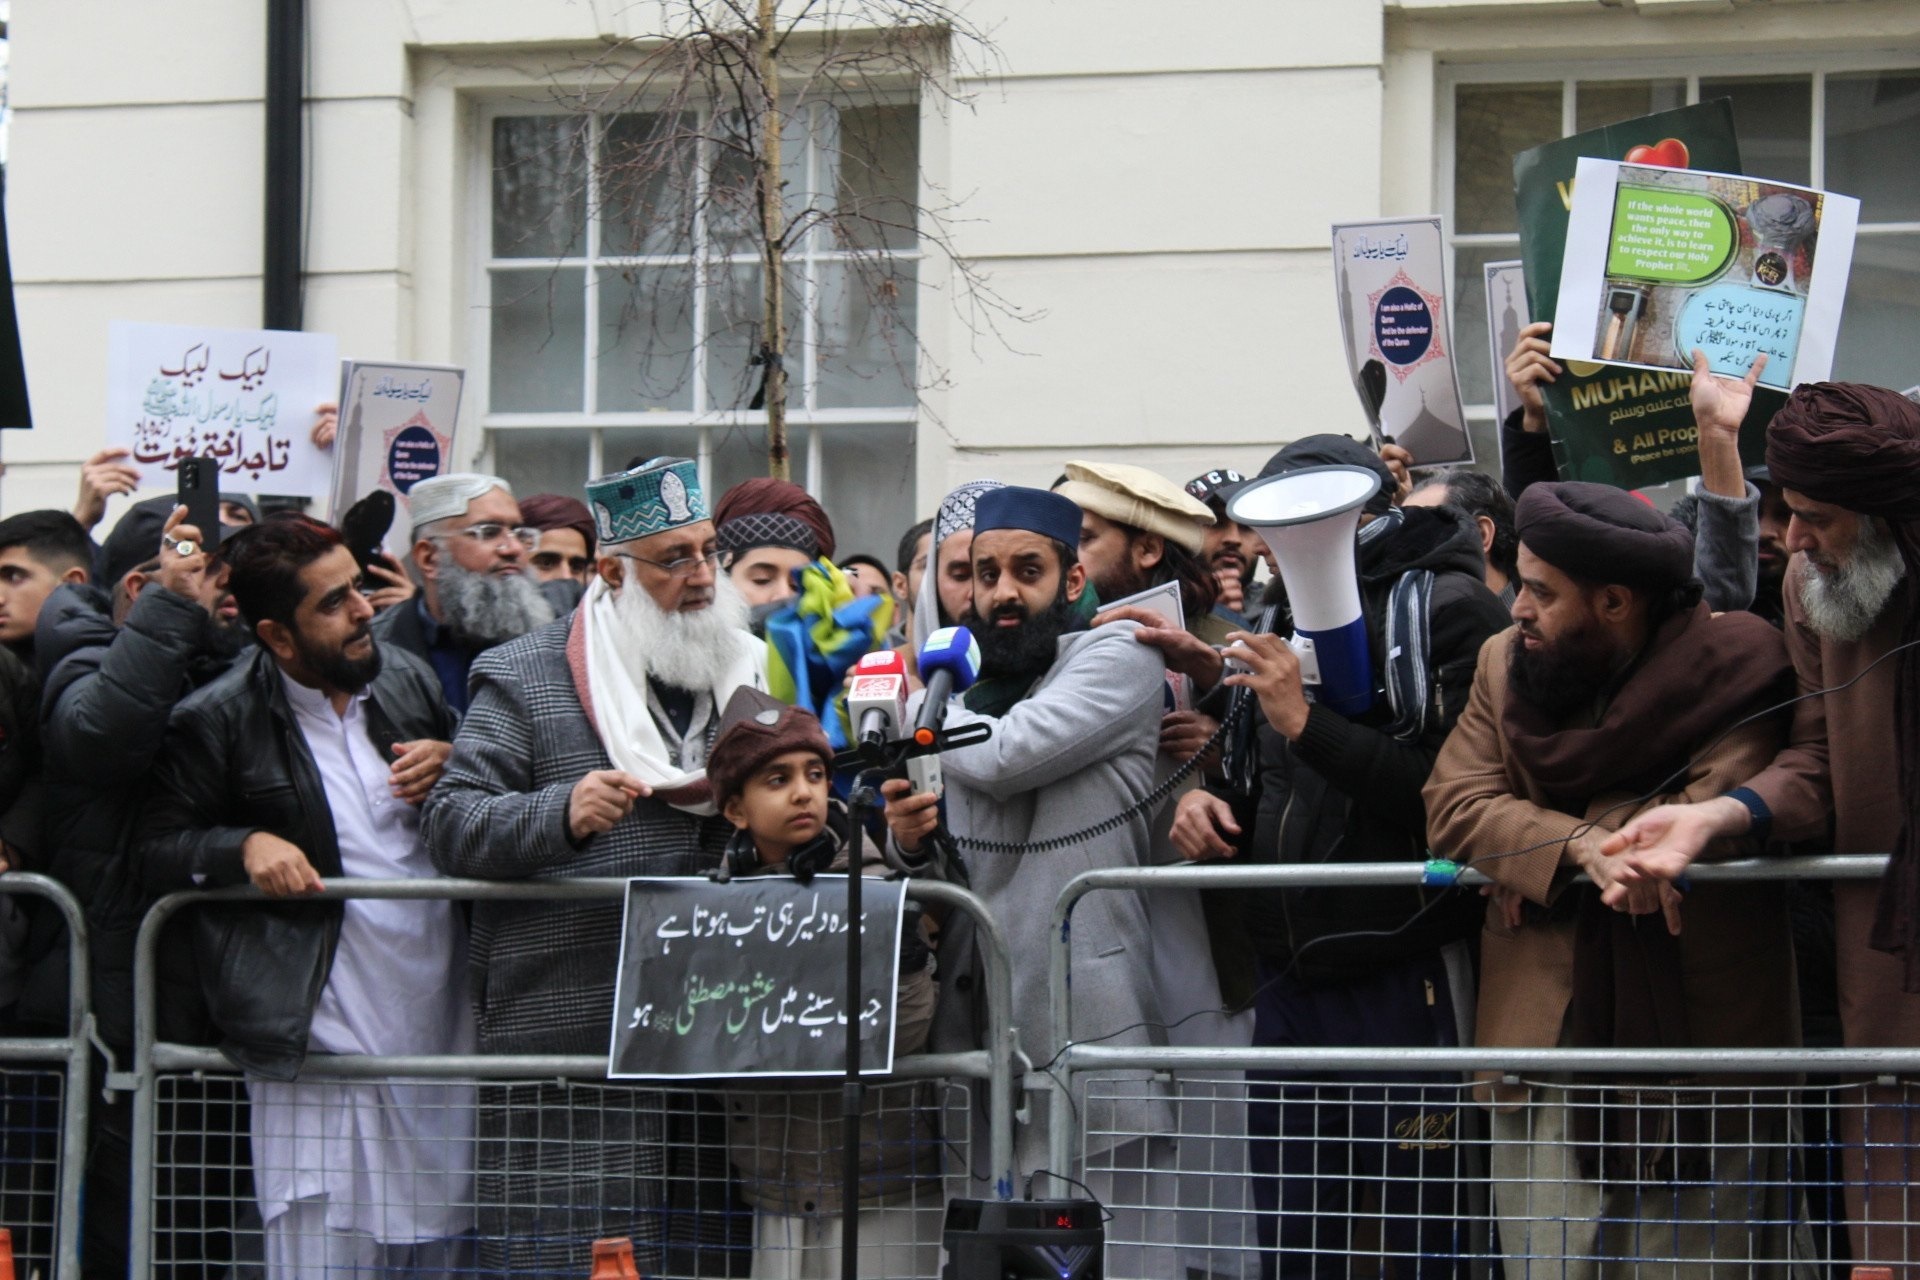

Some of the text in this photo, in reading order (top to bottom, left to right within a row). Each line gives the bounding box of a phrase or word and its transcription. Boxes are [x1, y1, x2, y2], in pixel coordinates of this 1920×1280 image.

[1627, 213, 1711, 229] wants peace, then
[1628, 200, 1713, 218] If the whole world
[1618, 234, 1714, 252] achieve it, is to learn
[1632, 223, 1704, 240] the only way to
[1619, 245, 1710, 263] to respect our Holy
[1635, 259, 1674, 271] Prophet
[160, 343, 270, 391] لبیک لبیک
[1613, 438, 1628, 454] &
[1632, 431, 1655, 450] All
[656, 914, 690, 955] ہے
[692, 904, 729, 938] ہوتا
[726, 905, 766, 948] تب
[766, 902, 794, 942] ہی
[628, 1003, 653, 1030] ہو
[761, 986, 798, 1034] میں
[798, 992, 835, 1037] سینے
